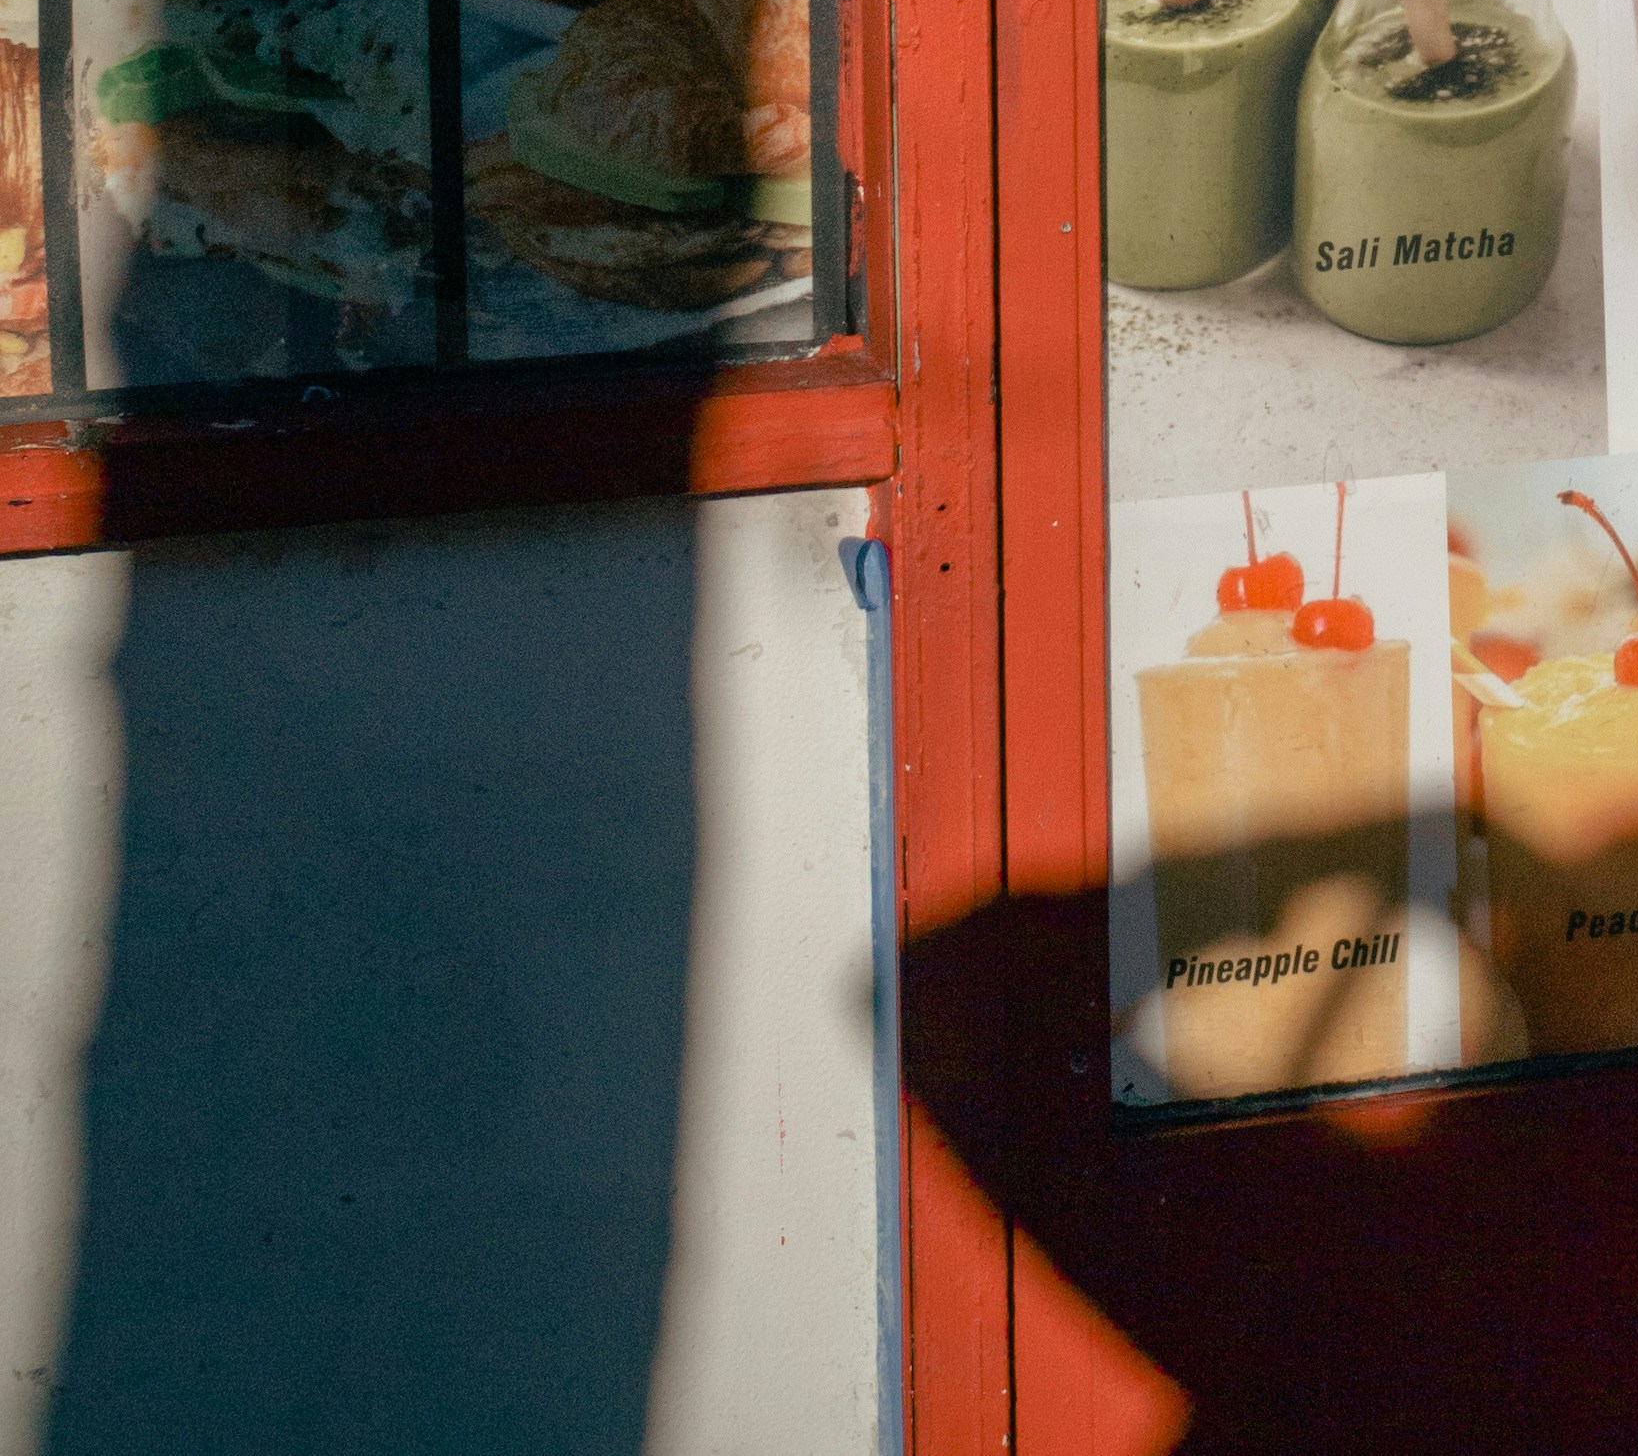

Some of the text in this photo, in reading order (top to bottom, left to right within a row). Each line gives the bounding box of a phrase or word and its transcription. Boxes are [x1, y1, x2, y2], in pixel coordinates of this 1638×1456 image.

[1314, 226, 1516, 272] Sali Matcha
[1164, 932, 1401, 990] Pineapple Chill
